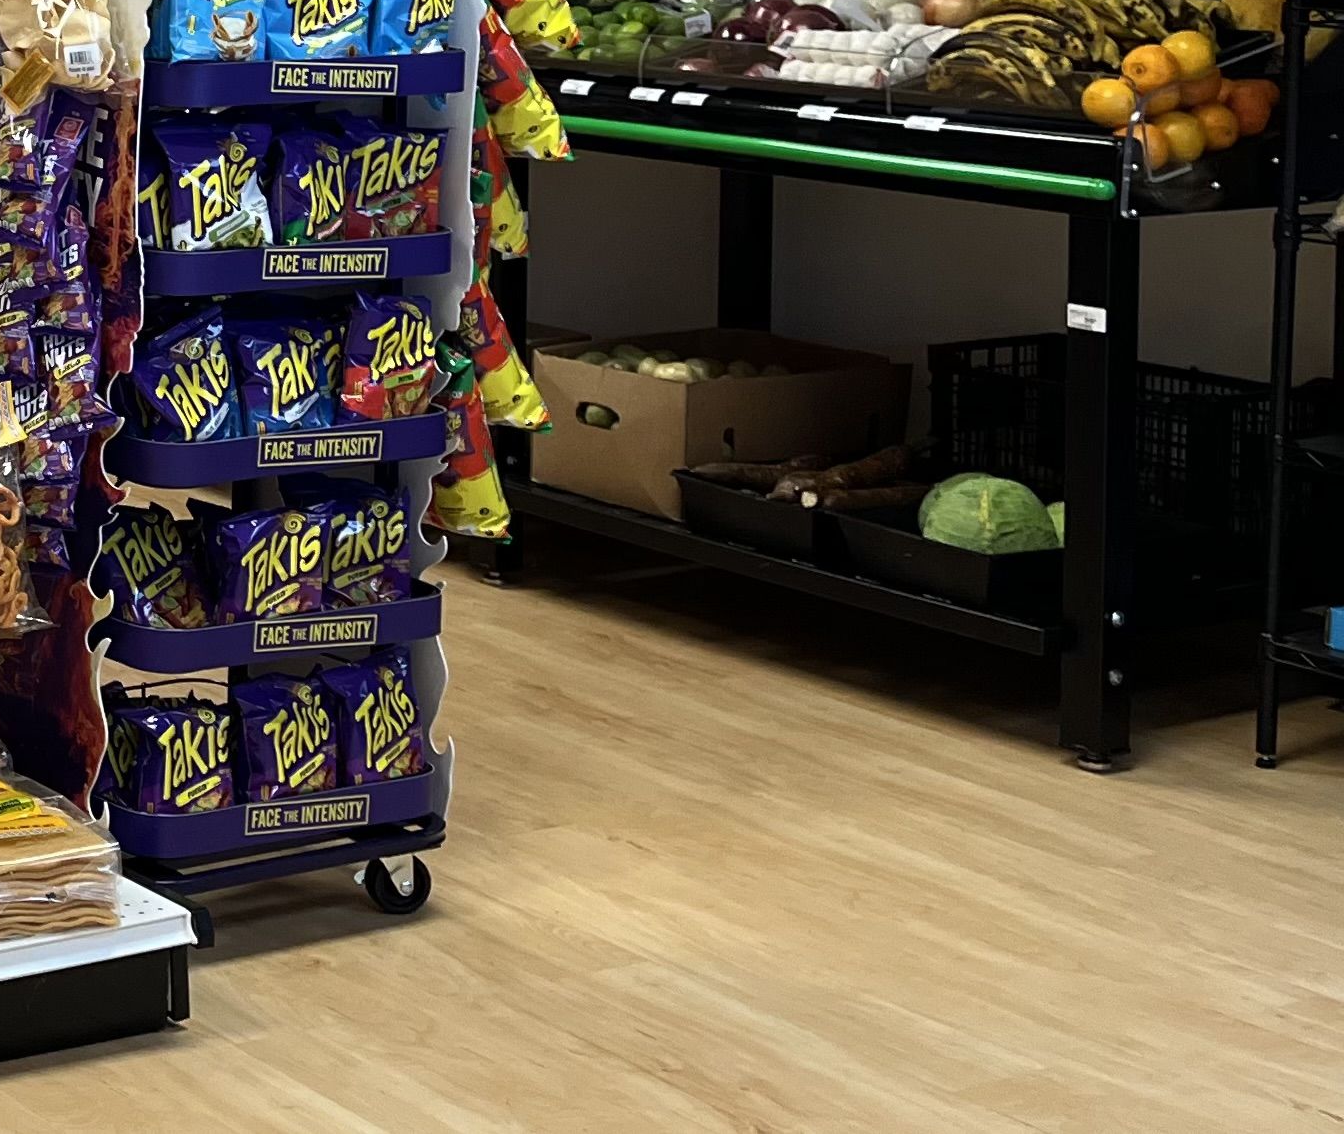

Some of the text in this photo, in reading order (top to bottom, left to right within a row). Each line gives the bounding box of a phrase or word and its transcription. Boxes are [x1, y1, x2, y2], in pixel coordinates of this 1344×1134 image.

[277, 68, 392, 89] FACE THE INTENSITY
[299, 145, 349, 236] Taki
[353, 133, 440, 209] Takis
[60, 244, 79, 267] TS
[269, 253, 382, 273] FACE THE INTENSITY
[156, 338, 229, 441] Takis
[257, 340, 315, 418] Tak
[264, 437, 377, 460] FACE THE INTENSITY
[103, 512, 183, 593] Takis
[241, 514, 321, 612] Takis
[260, 620, 372, 646] FACE THE INTENSITY
[158, 708, 230, 801] Takis
[264, 685, 330, 783] Takis
[355, 669, 415, 768] Takis
[251, 801, 364, 828] FACE THE INTENSITY
